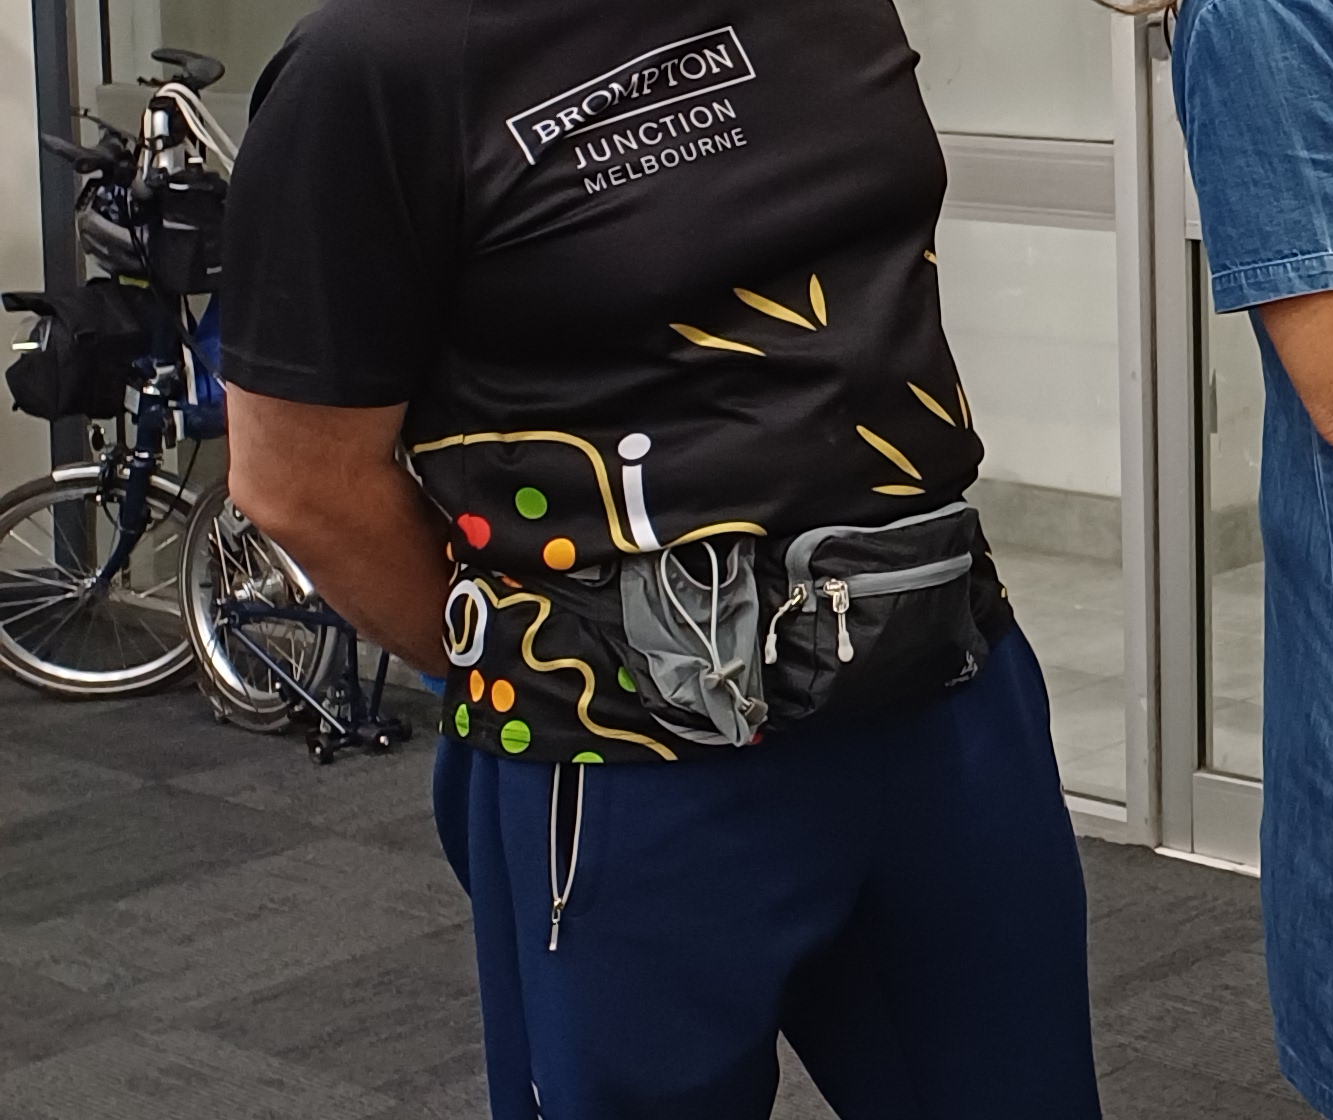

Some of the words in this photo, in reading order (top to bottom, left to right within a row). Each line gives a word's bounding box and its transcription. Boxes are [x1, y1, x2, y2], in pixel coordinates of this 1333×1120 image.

[532, 44, 734, 144] BROMPTON
[573, 98, 737, 169] JUNCTION
[583, 128, 748, 194] MELBOURNE
